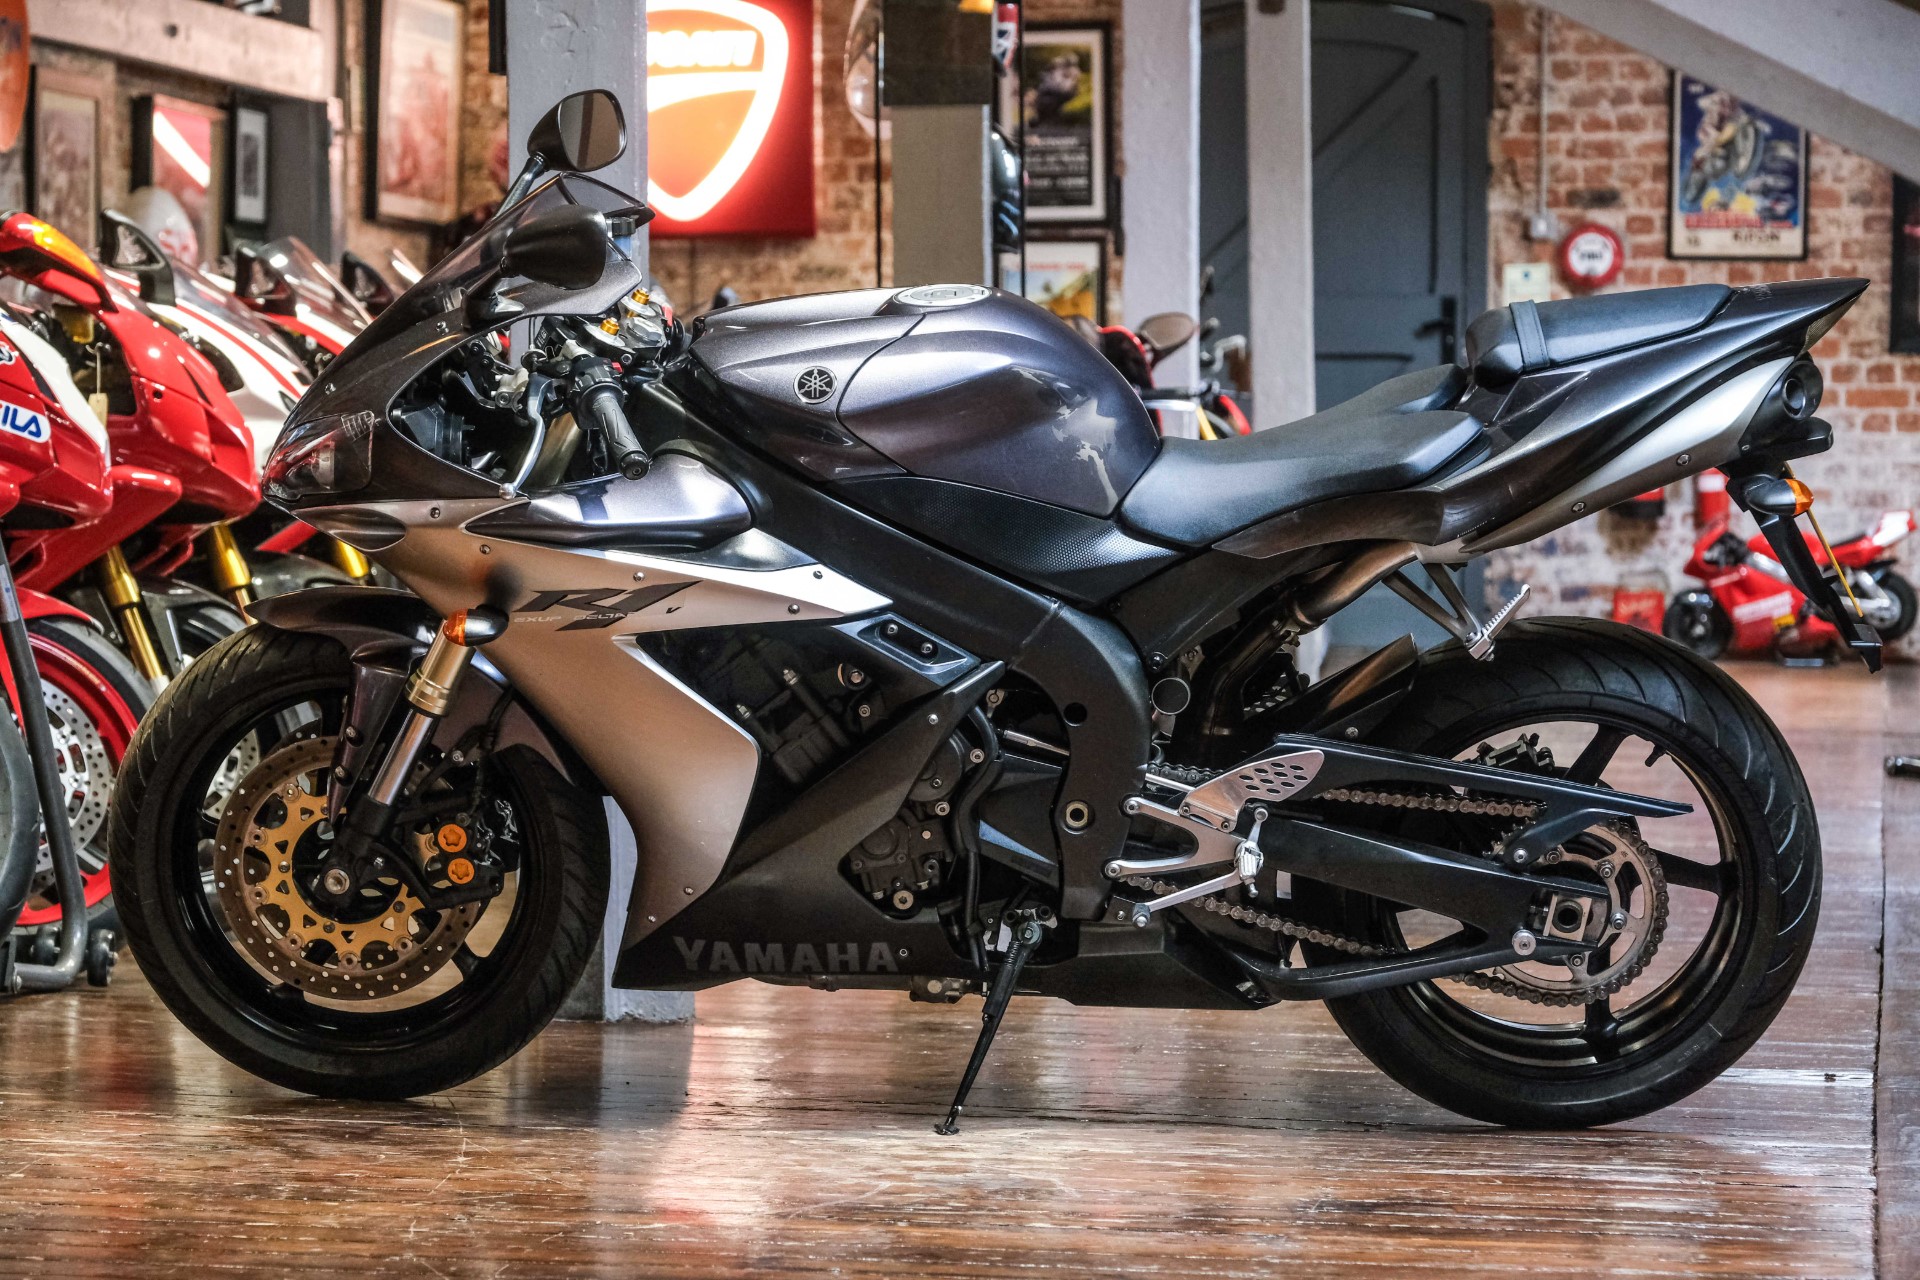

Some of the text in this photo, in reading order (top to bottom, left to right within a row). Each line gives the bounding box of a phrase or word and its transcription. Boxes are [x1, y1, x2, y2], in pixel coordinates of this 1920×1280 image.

[0, 403, 42, 439] ILA
[512, 580, 704, 632] R1
[514, 615, 562, 623] EXUP
[672, 935, 899, 973] YAMAHA
